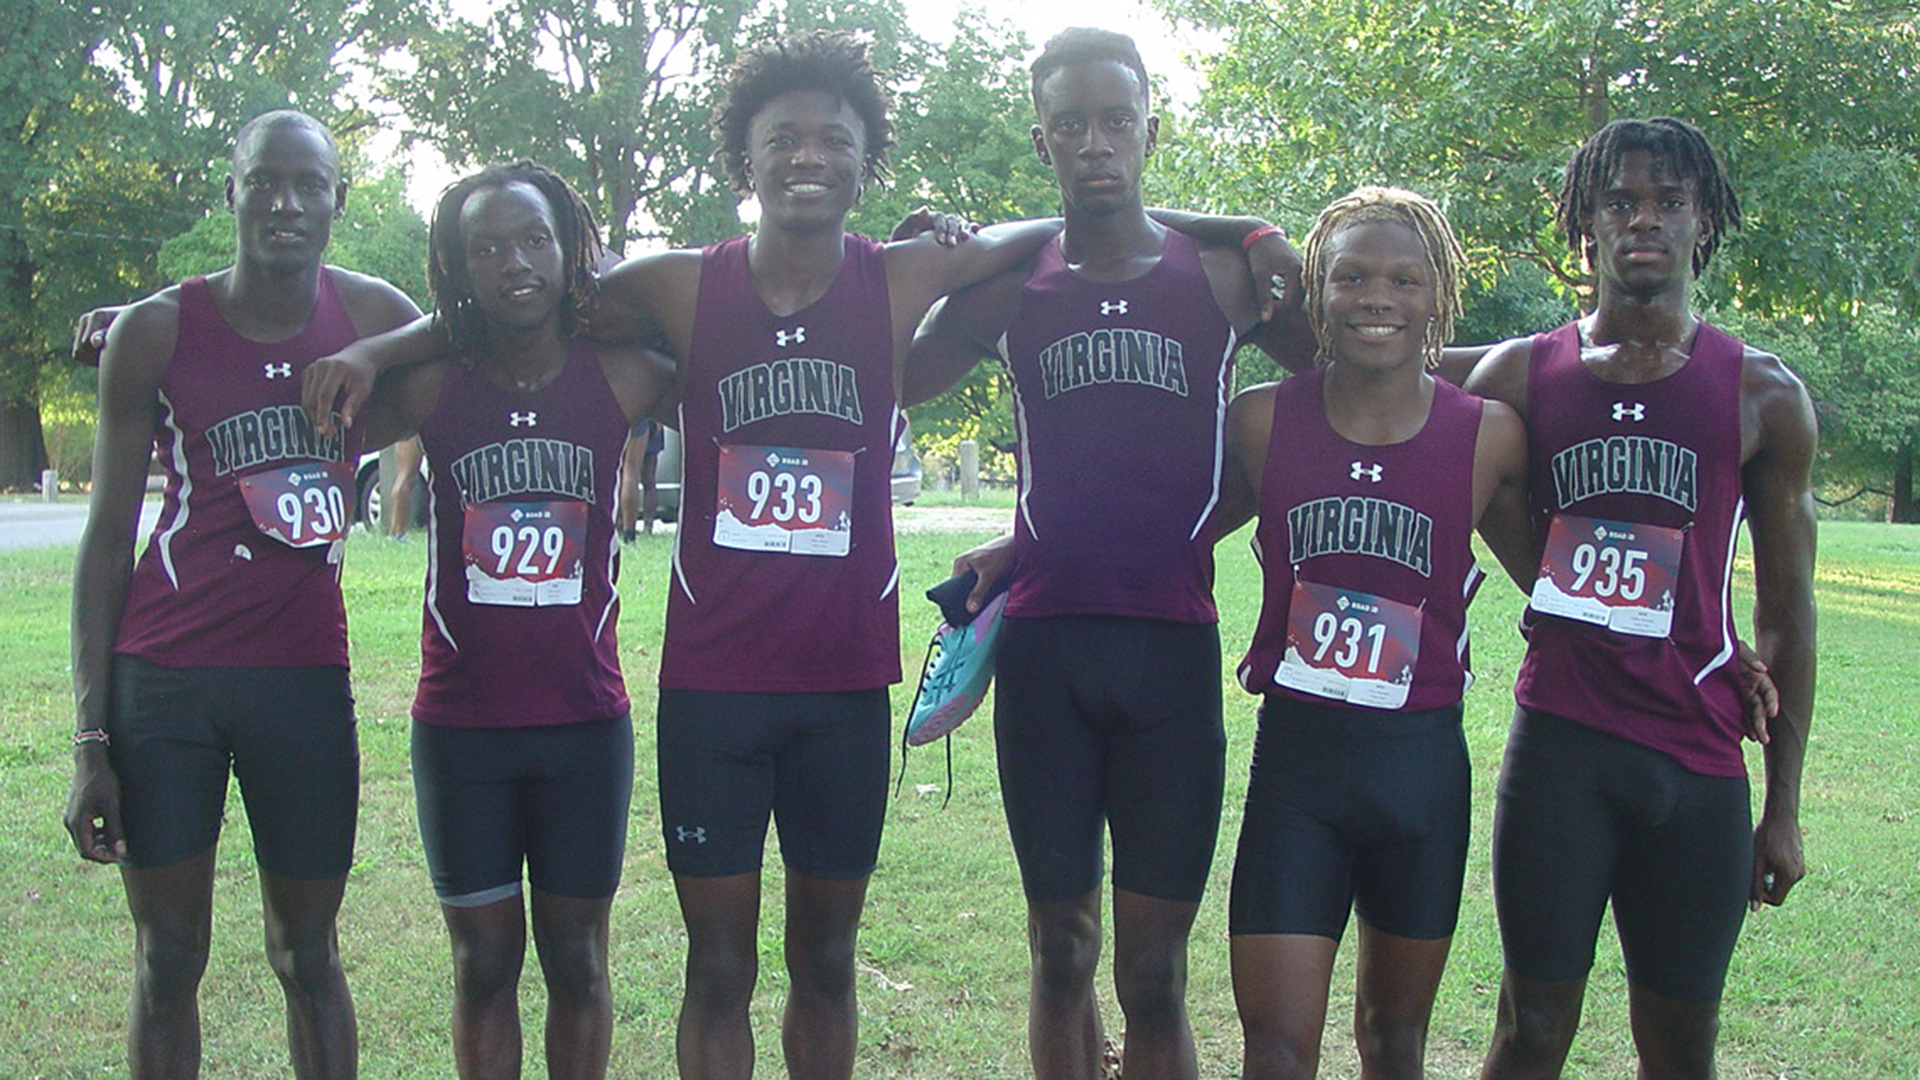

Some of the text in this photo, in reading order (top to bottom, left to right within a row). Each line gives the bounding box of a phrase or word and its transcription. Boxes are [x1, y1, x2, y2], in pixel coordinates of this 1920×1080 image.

[718, 358, 863, 433] VIRGINIA
[1039, 328, 1189, 400] VIRGINIA
[451, 438, 596, 511] VIRGINIA
[747, 471, 822, 523] 933
[1552, 436, 1698, 513] VIRGINIA
[277, 485, 346, 540] 930
[1287, 497, 1433, 578] VIRGINIA
[491, 525, 564, 574] 929
[1570, 543, 1648, 601] 935
[1313, 612, 1386, 674] 931
